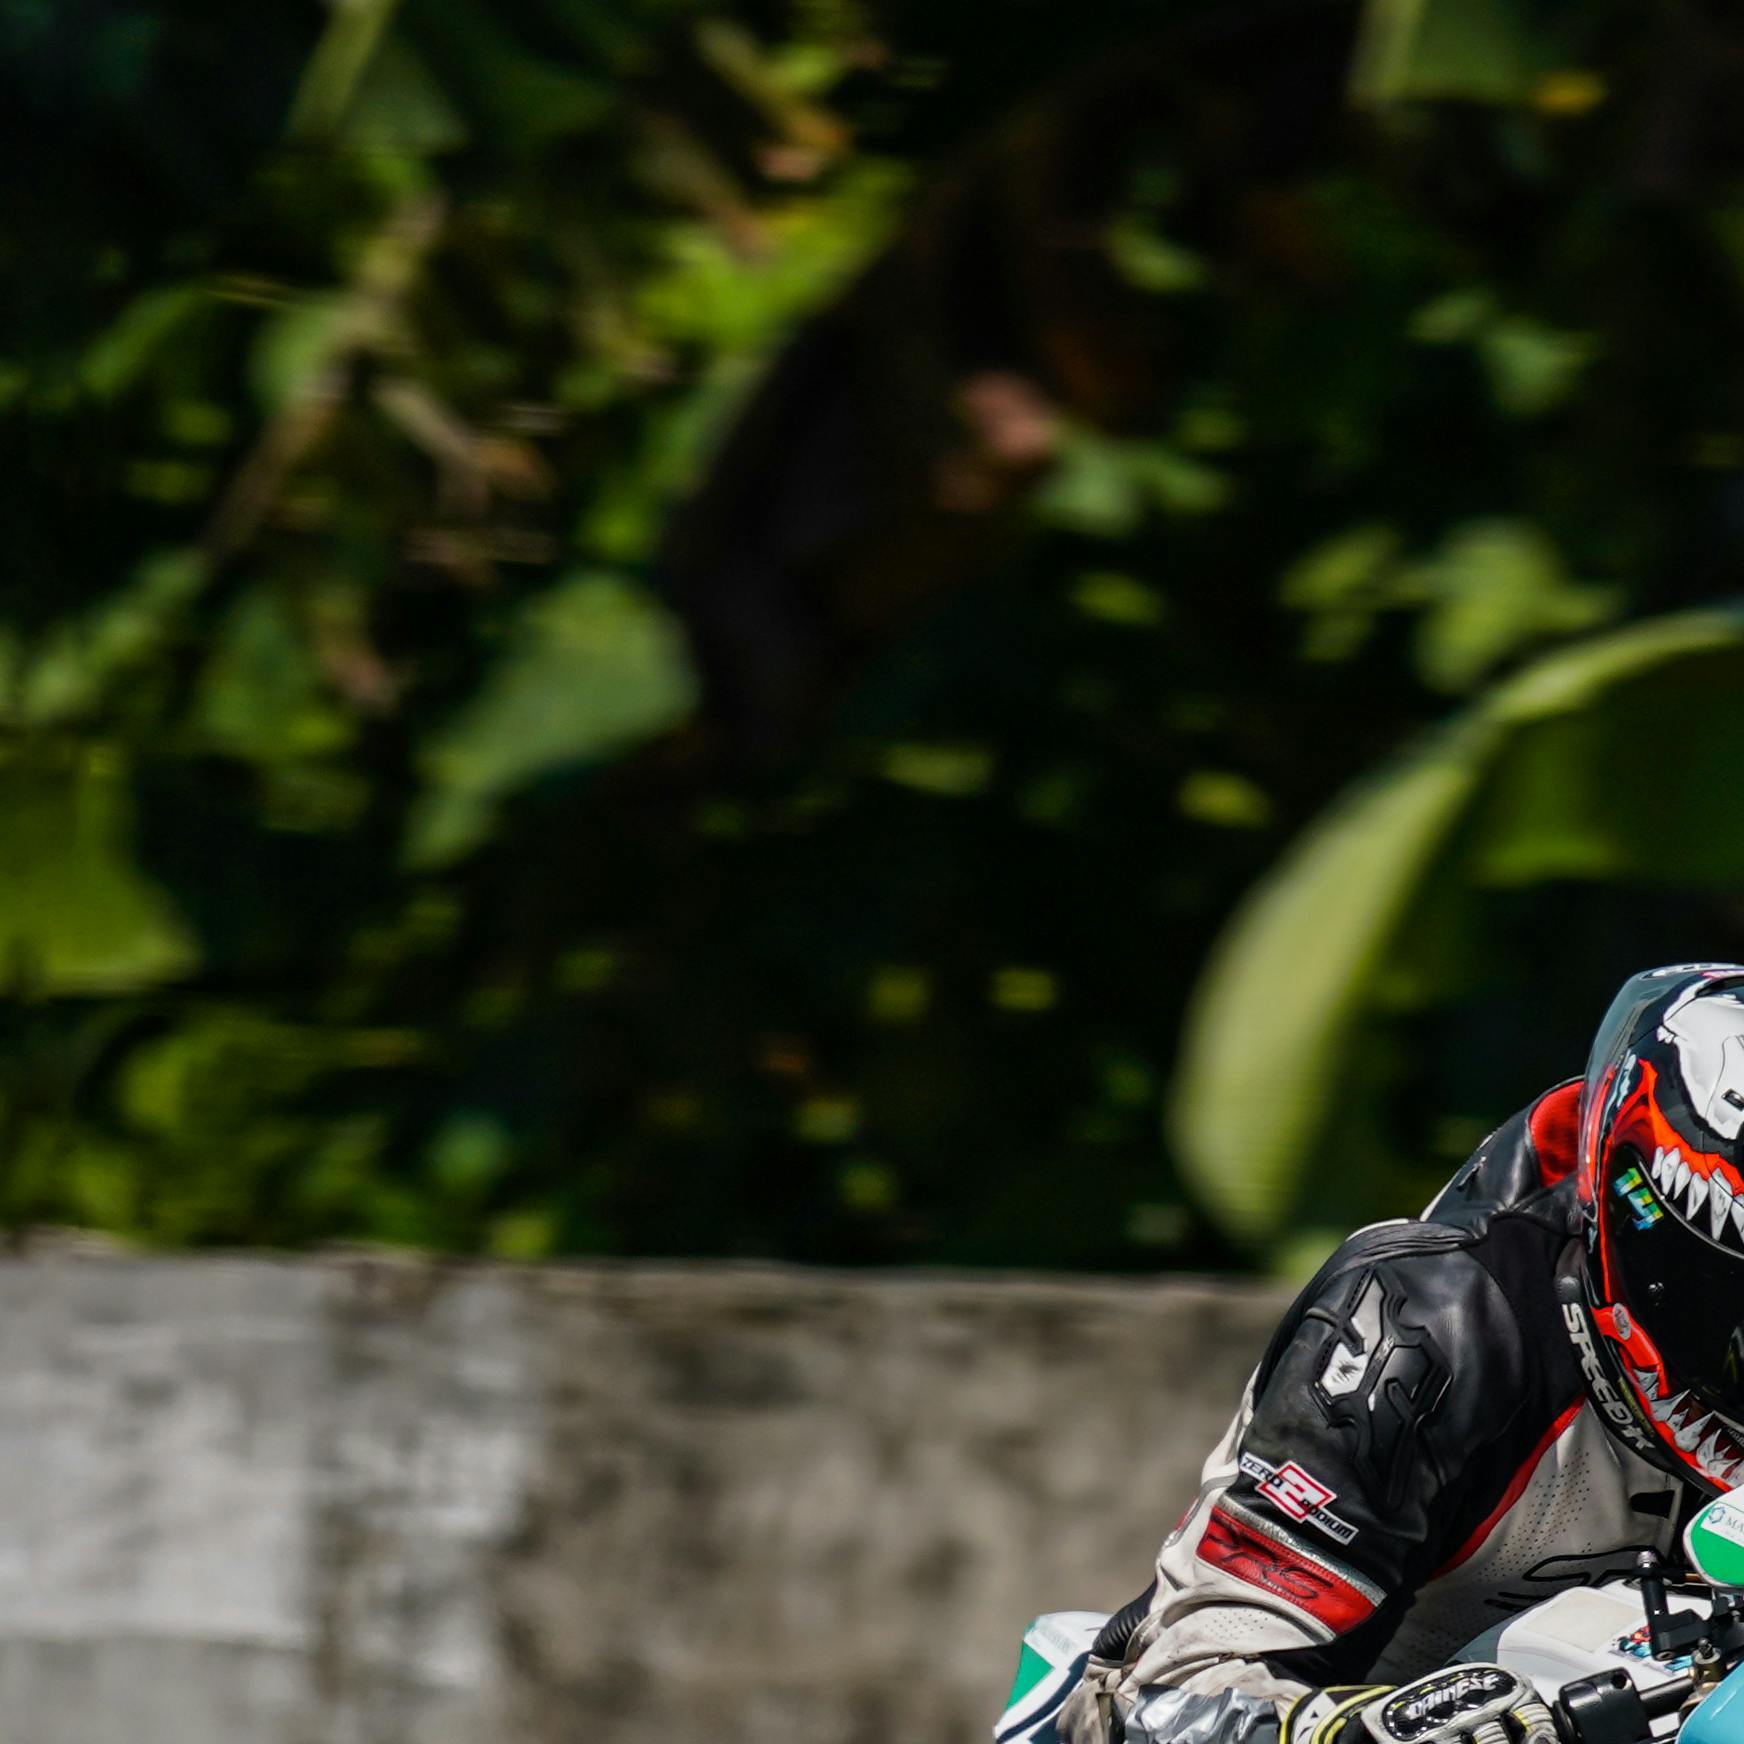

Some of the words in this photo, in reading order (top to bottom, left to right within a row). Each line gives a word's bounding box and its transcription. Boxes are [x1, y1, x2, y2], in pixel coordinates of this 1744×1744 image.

[1241, 1456, 1284, 1490] ZERO
[1302, 1498, 1357, 1541] PODIUM
[1406, 1673, 1500, 1721] DAINESE
